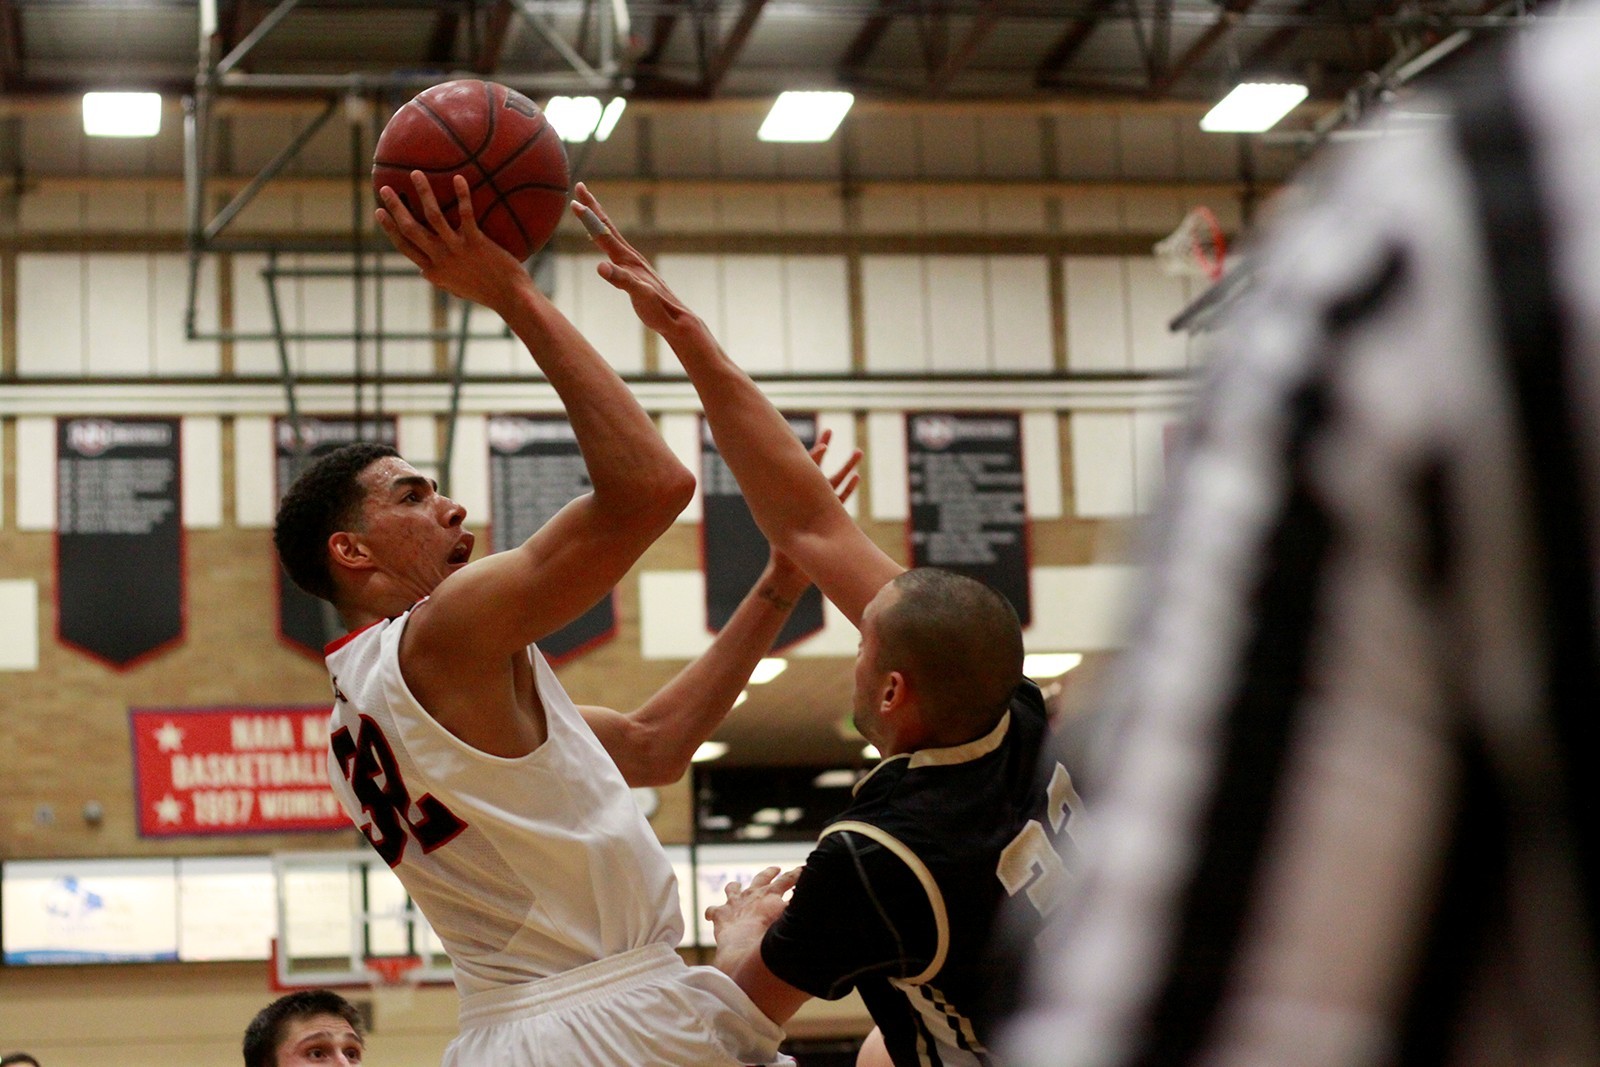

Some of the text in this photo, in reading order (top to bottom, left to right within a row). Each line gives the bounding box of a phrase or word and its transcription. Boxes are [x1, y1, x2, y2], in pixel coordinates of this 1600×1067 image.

[231, 716, 294, 749] NAIA
[171, 752, 331, 789] BASKETBALL
[331, 713, 469, 869] 32
